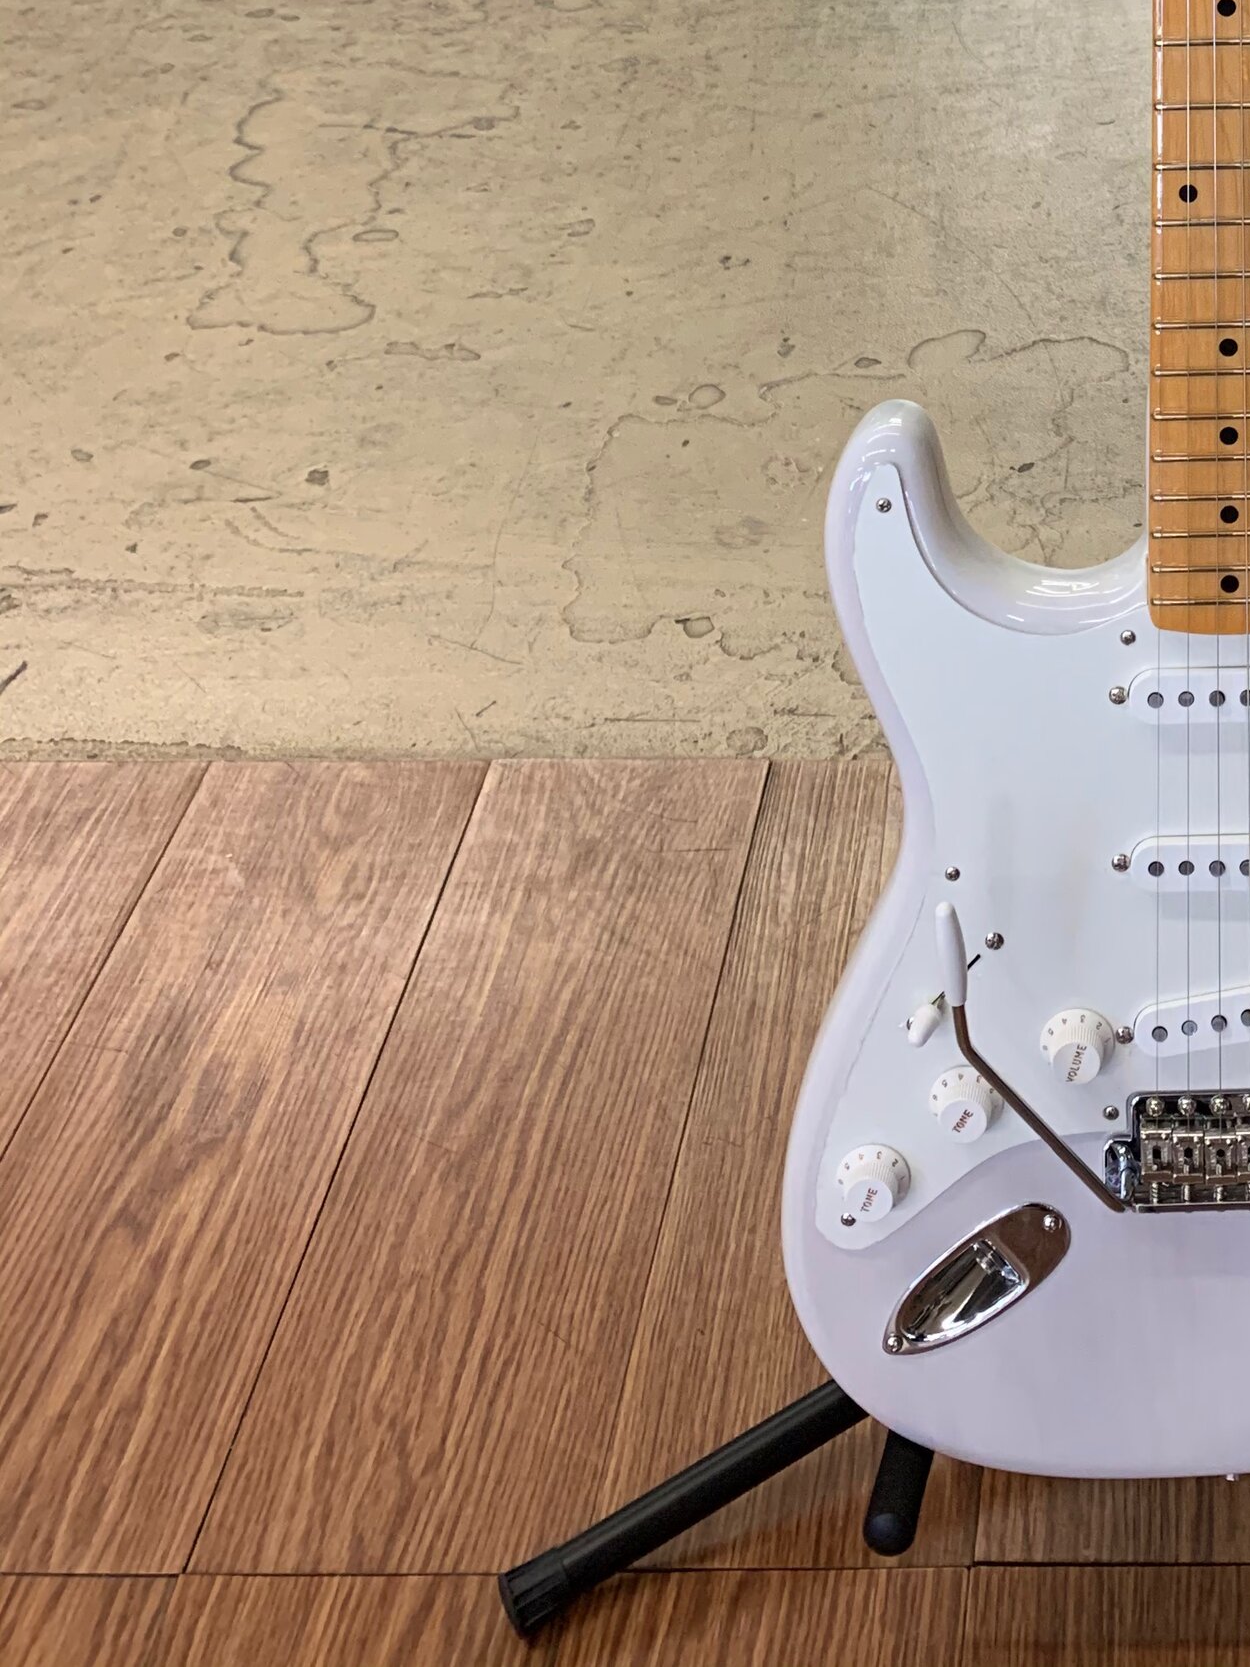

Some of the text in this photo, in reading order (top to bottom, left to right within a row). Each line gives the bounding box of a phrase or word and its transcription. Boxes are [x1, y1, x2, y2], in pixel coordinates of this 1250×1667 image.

[1065, 1044, 1087, 1084] VOLUME
[951, 1109, 974, 1134] TONE
[860, 1187, 878, 1213] TONE
